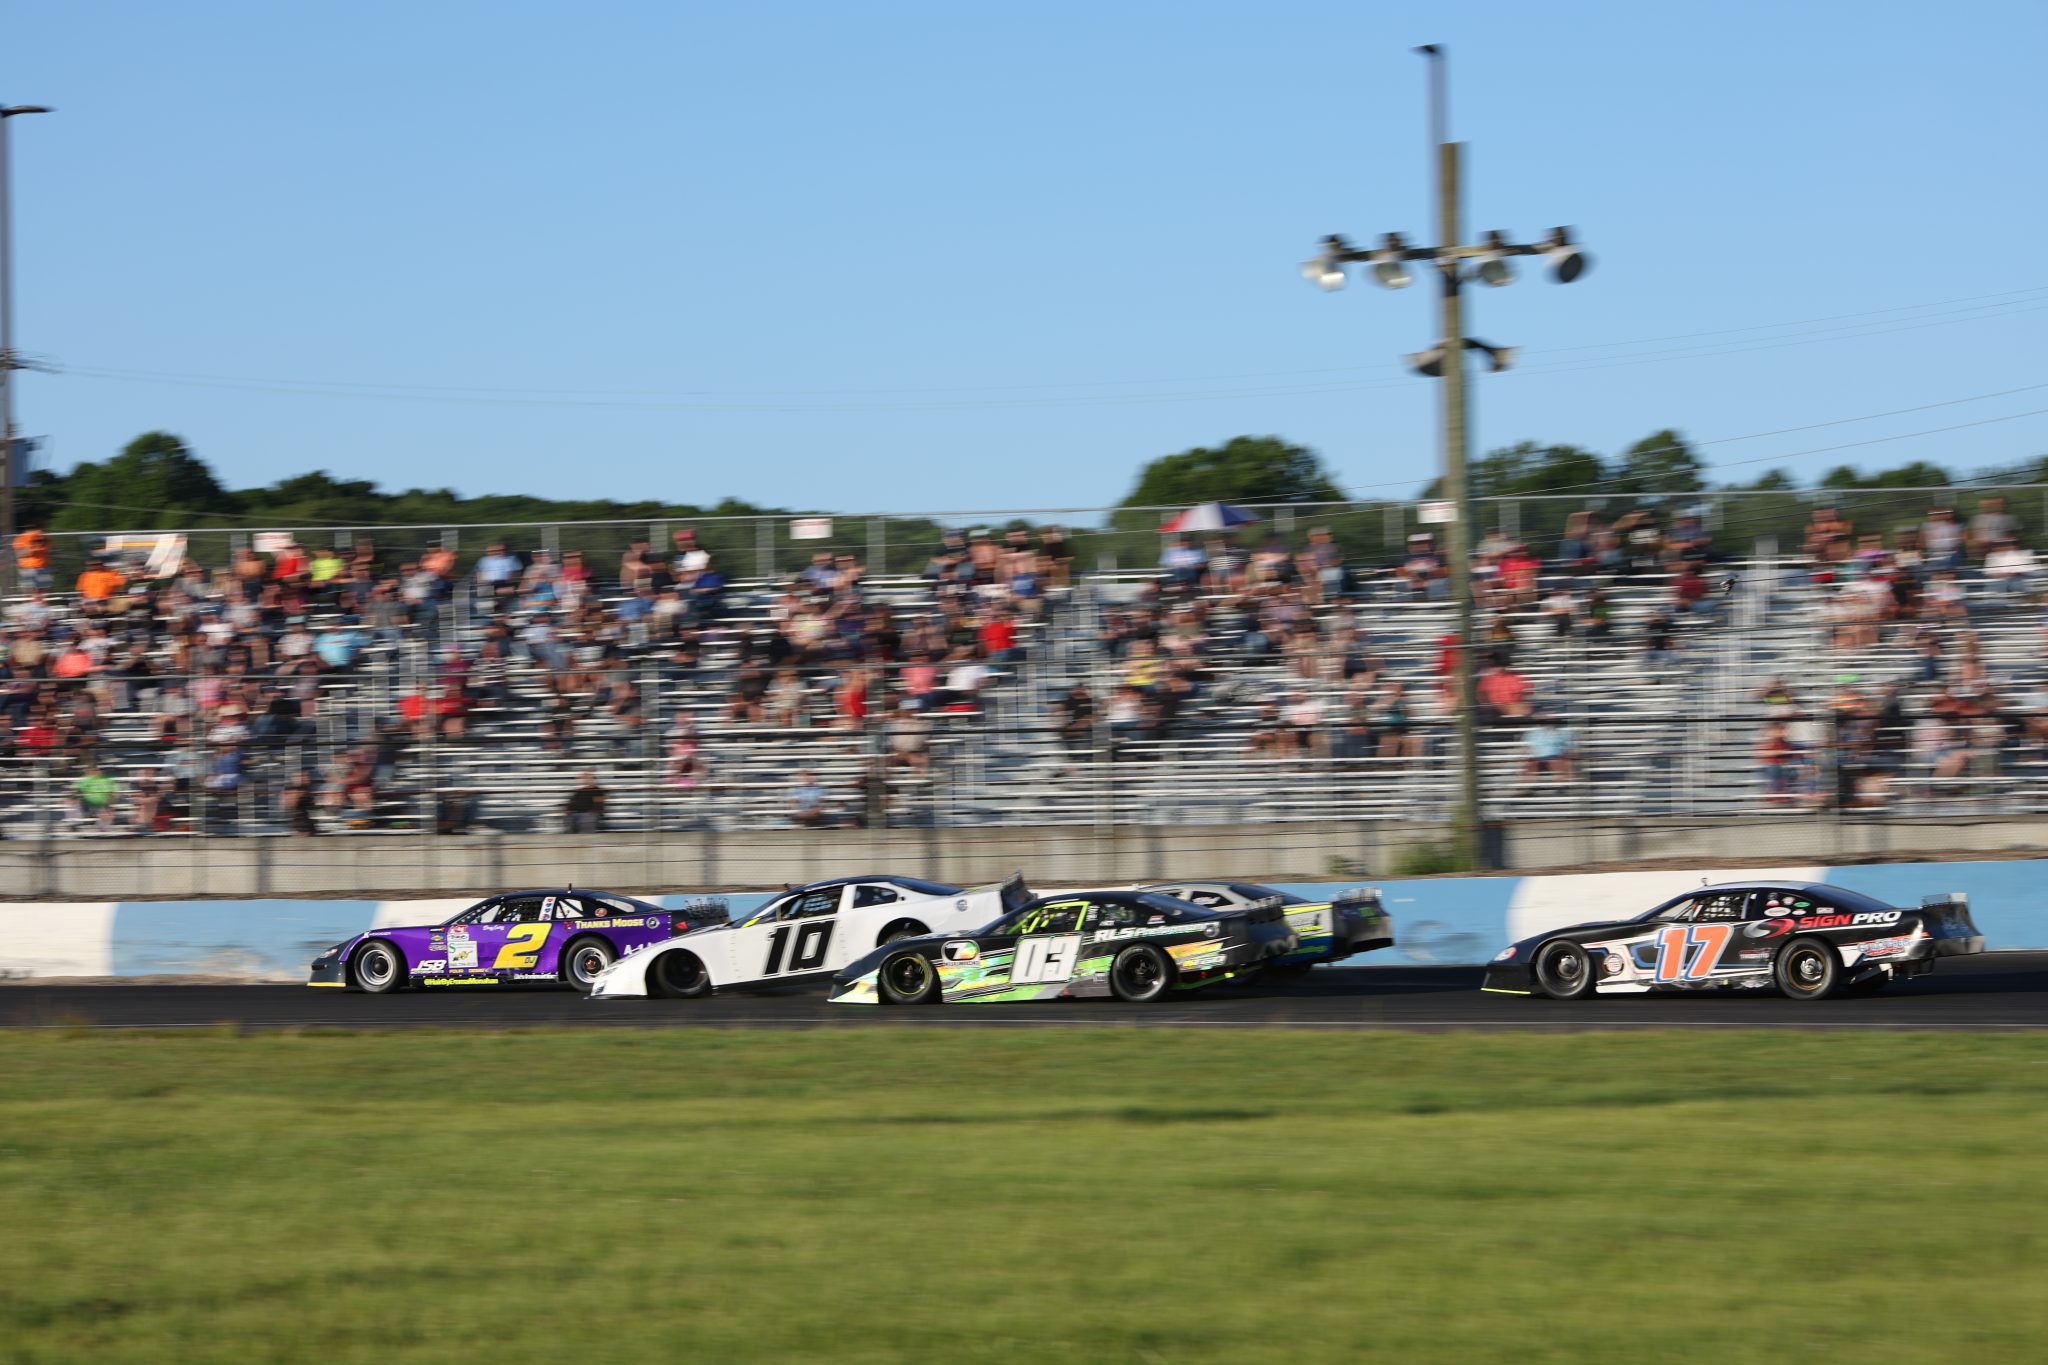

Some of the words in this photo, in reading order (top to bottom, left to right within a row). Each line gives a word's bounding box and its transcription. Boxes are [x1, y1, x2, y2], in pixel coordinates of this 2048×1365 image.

[575, 920, 610, 929] THANKS
[612, 918, 644, 928] MOOSE
[1094, 927, 1137, 941] RLS
[1798, 914, 1853, 929] SIGN
[1852, 911, 1902, 925] PRO
[492, 923, 552, 969] 2
[763, 919, 837, 976] 10
[1010, 935, 1082, 984] 03
[1656, 924, 1733, 982] 17
[411, 960, 447, 971] JSB
